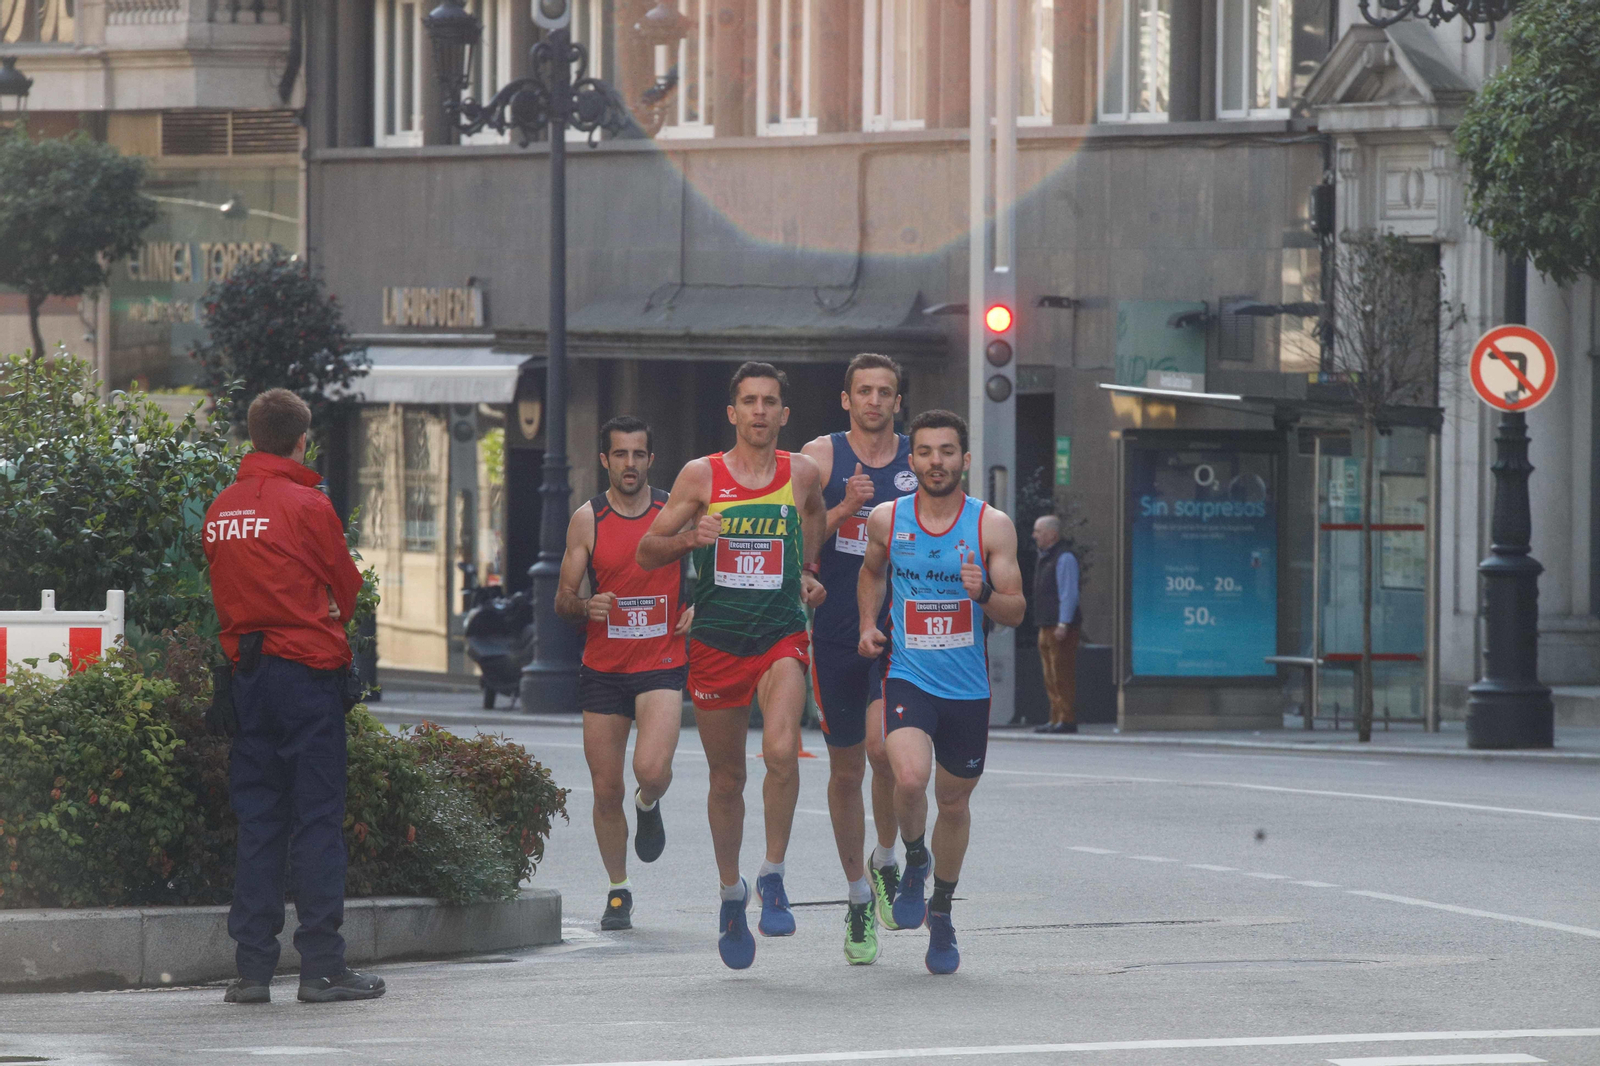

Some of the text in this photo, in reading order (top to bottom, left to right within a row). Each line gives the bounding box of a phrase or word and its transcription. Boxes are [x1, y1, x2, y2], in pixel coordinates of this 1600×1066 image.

[1140, 496, 1265, 522] Sin sorpresas
[206, 518, 270, 543] STAFF
[719, 517, 788, 536] BIKILA
[734, 556, 765, 574] 102
[926, 570, 963, 583] Atleti
[627, 611, 648, 627] 36
[924, 617, 953, 635] 137
